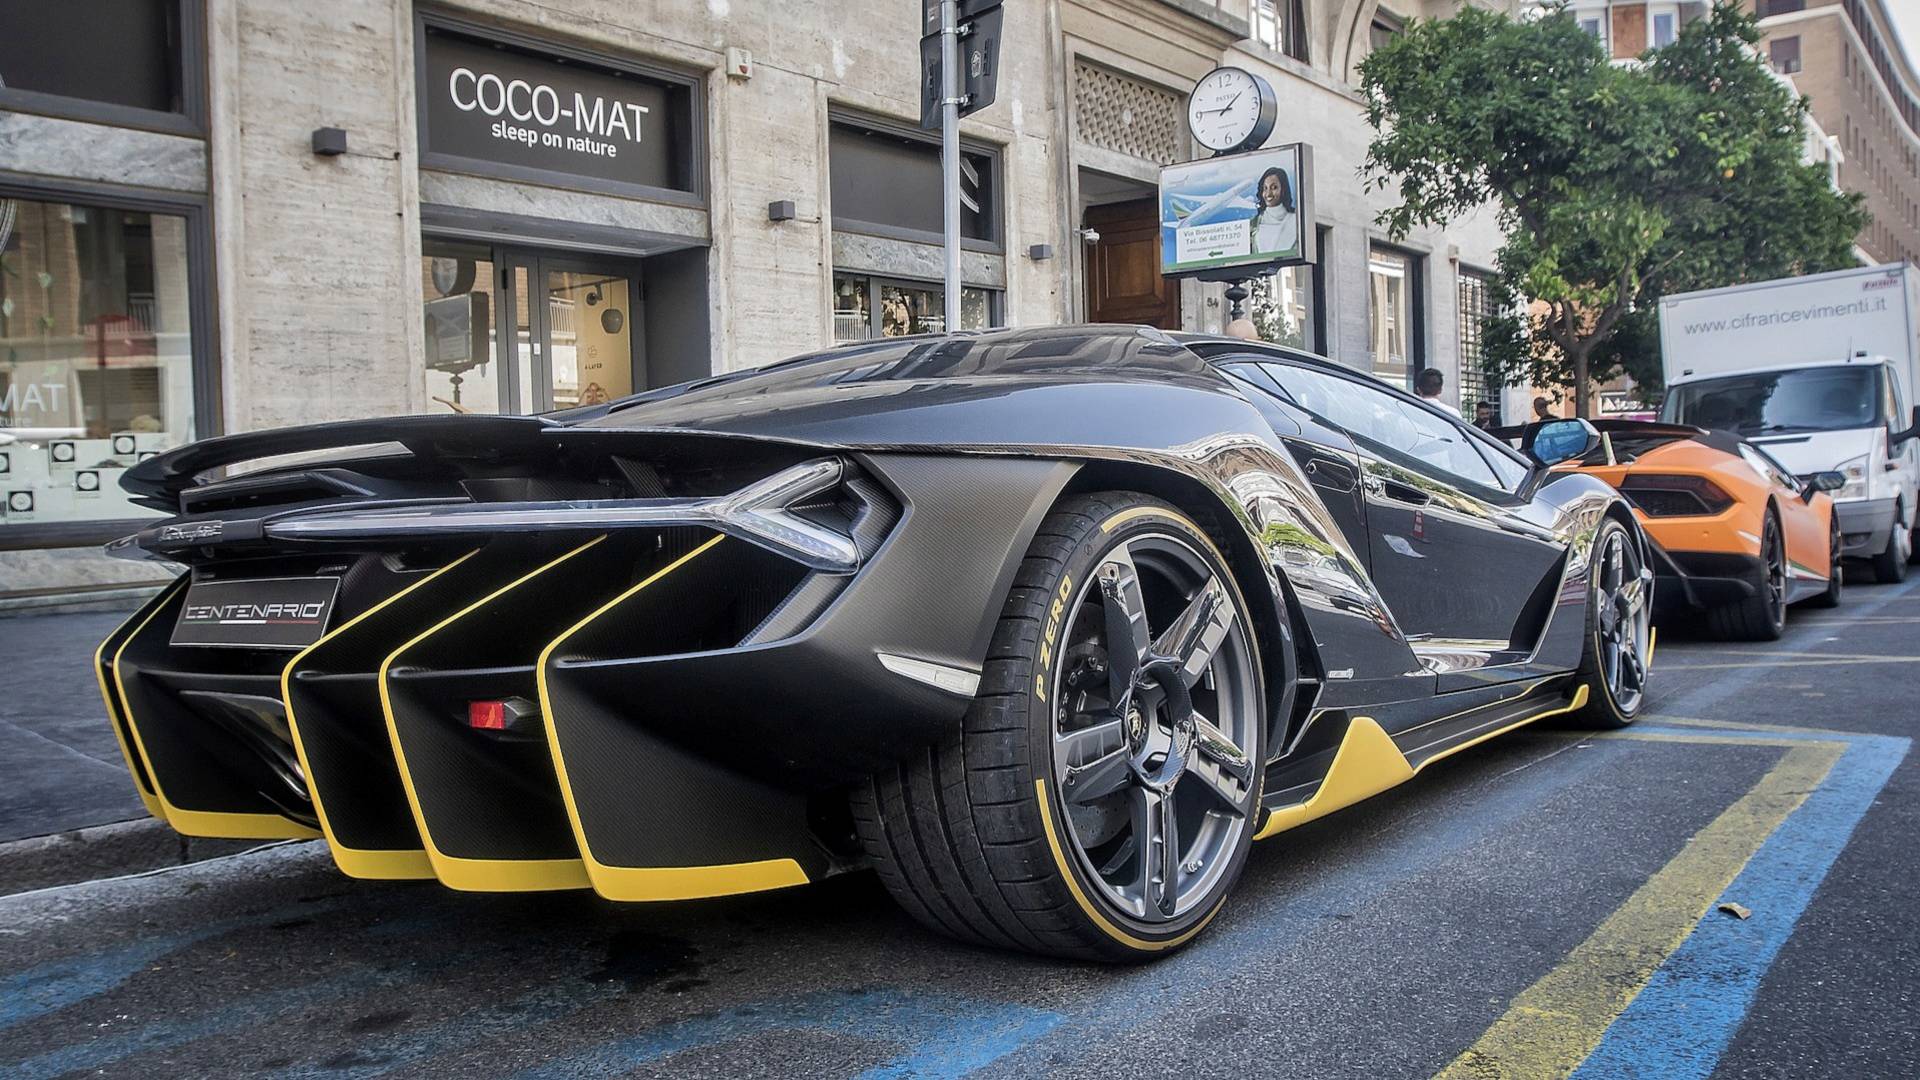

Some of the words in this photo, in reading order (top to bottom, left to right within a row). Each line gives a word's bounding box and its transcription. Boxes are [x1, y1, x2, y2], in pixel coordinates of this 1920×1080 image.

[1218, 73, 1232, 88] 12
[450, 67, 649, 143] COCO-MAT
[1251, 96, 1259, 110] 3
[491, 120, 538, 148] sleep
[542, 132, 562, 148] on
[567, 137, 617, 157] nature
[1224, 131, 1233, 145] 6
[1684, 297, 1888, 335] www.cifraricevimenti.it
[185, 600, 326, 620] CENTENARIO
[1040, 574, 1073, 671] ZERO
[1036, 673, 1046, 703] P
